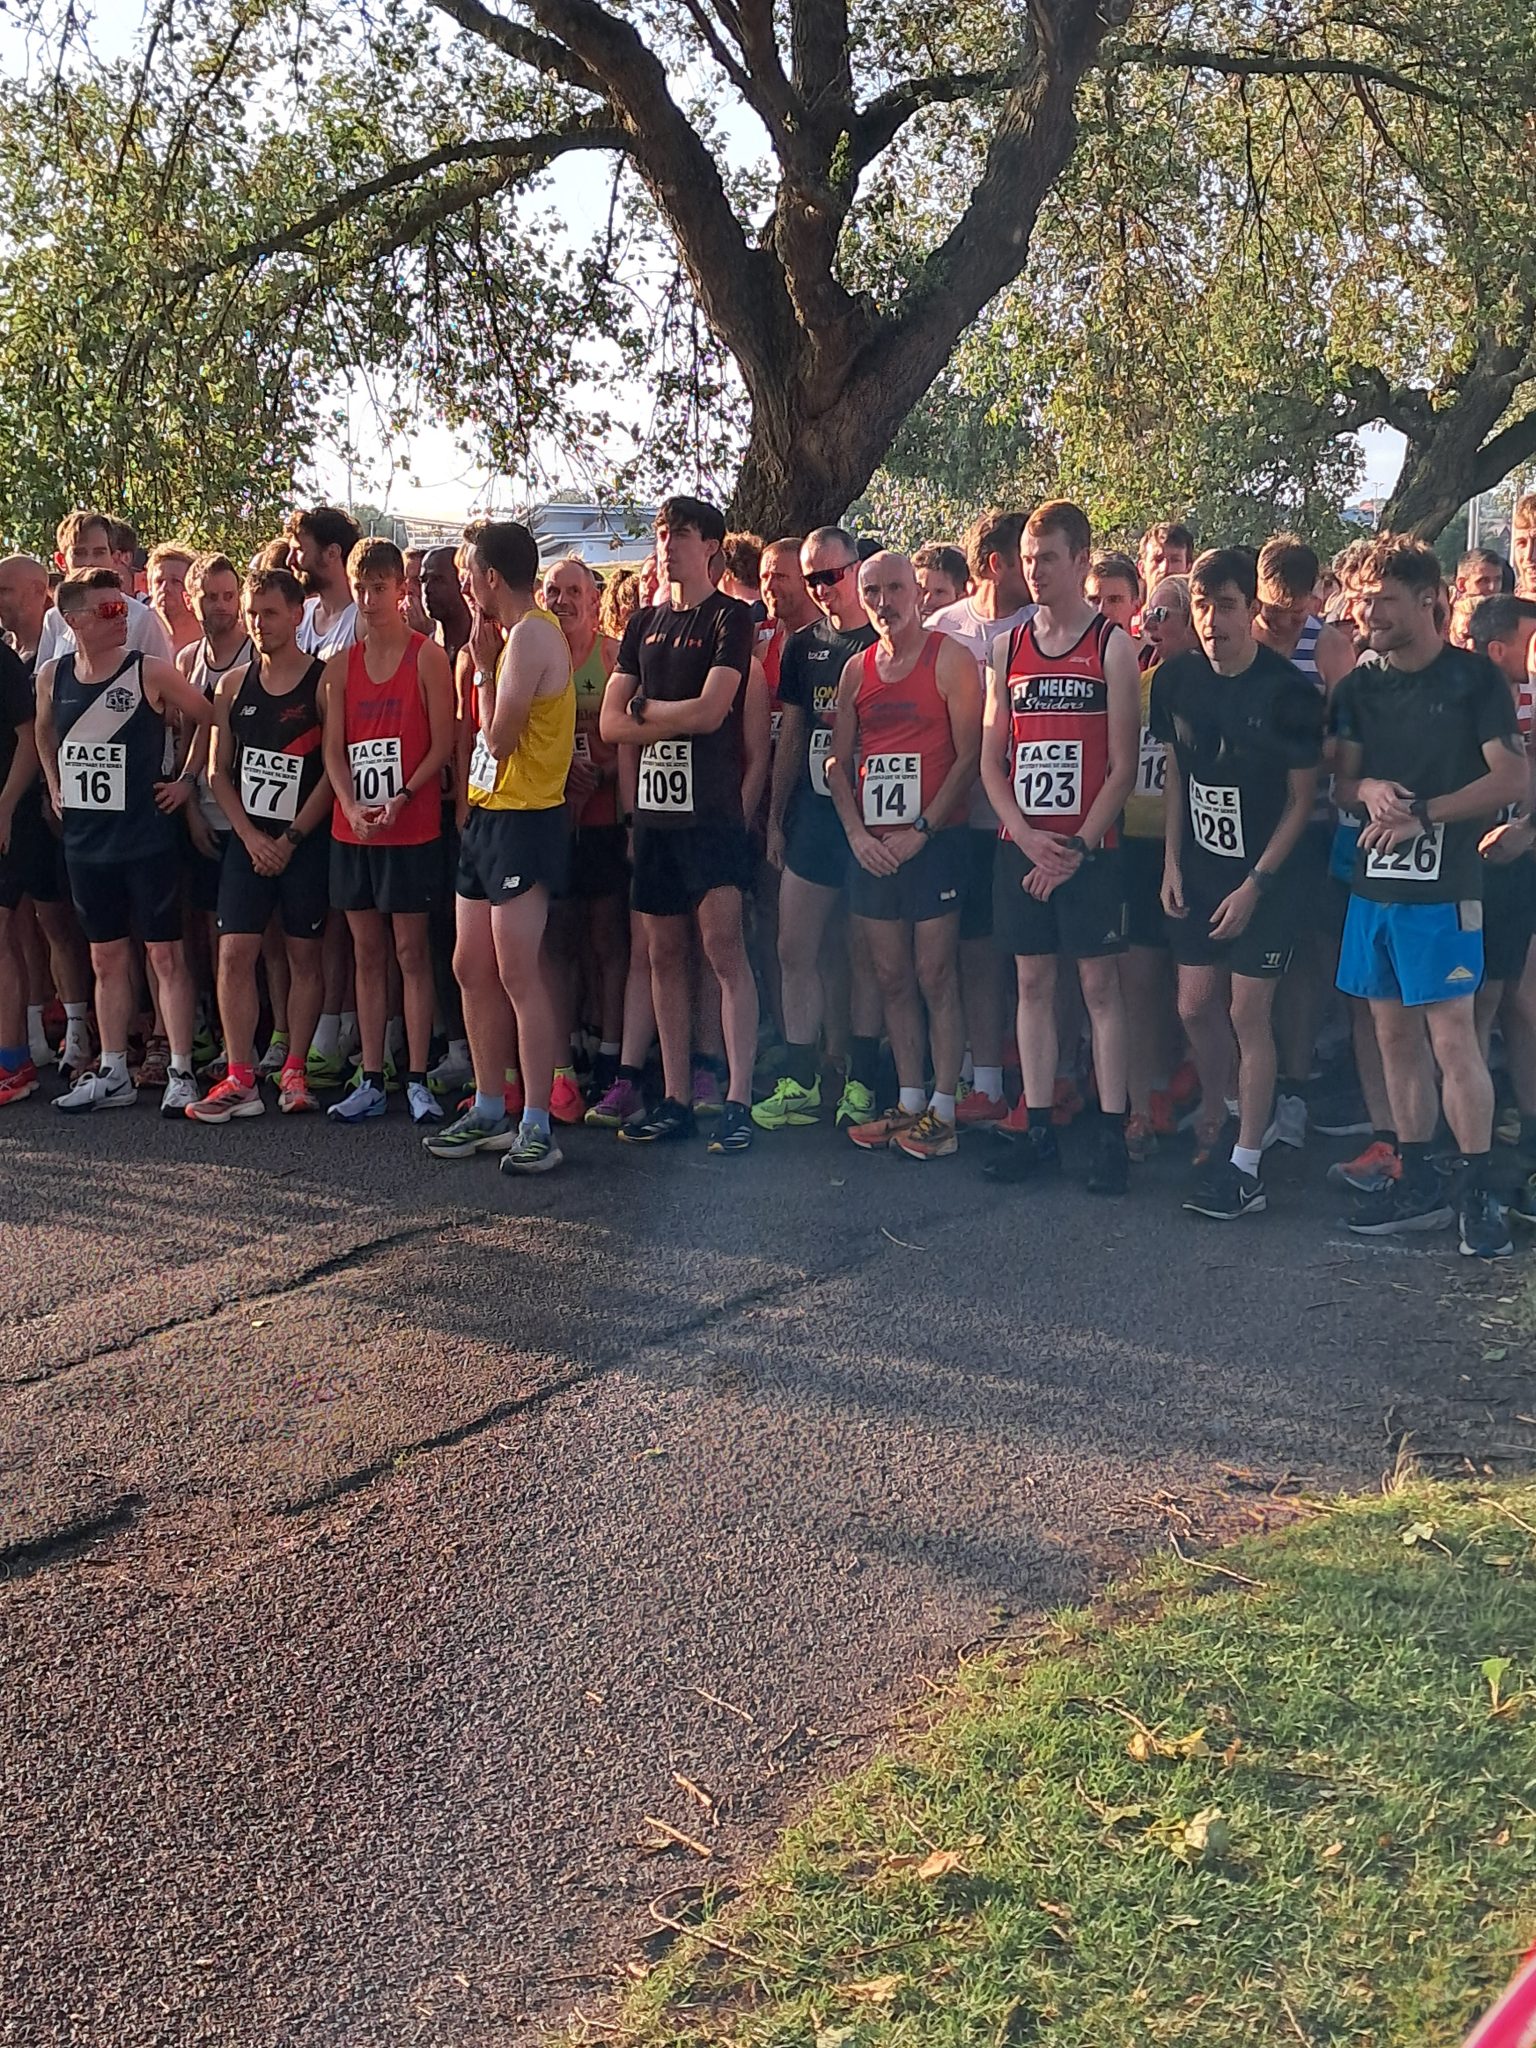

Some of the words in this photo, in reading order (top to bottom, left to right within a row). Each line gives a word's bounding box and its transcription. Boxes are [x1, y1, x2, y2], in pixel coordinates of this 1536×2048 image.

[1021, 697, 1084, 710] Striders
[1039, 678, 1094, 698] HELENS
[75, 770, 112, 804] 16
[249, 775, 289, 812] 77
[352, 765, 395, 801] 101
[642, 769, 688, 804] 109
[871, 783, 907, 818] 14
[1019, 771, 1076, 808] 123
[1193, 808, 1237, 850] 128
